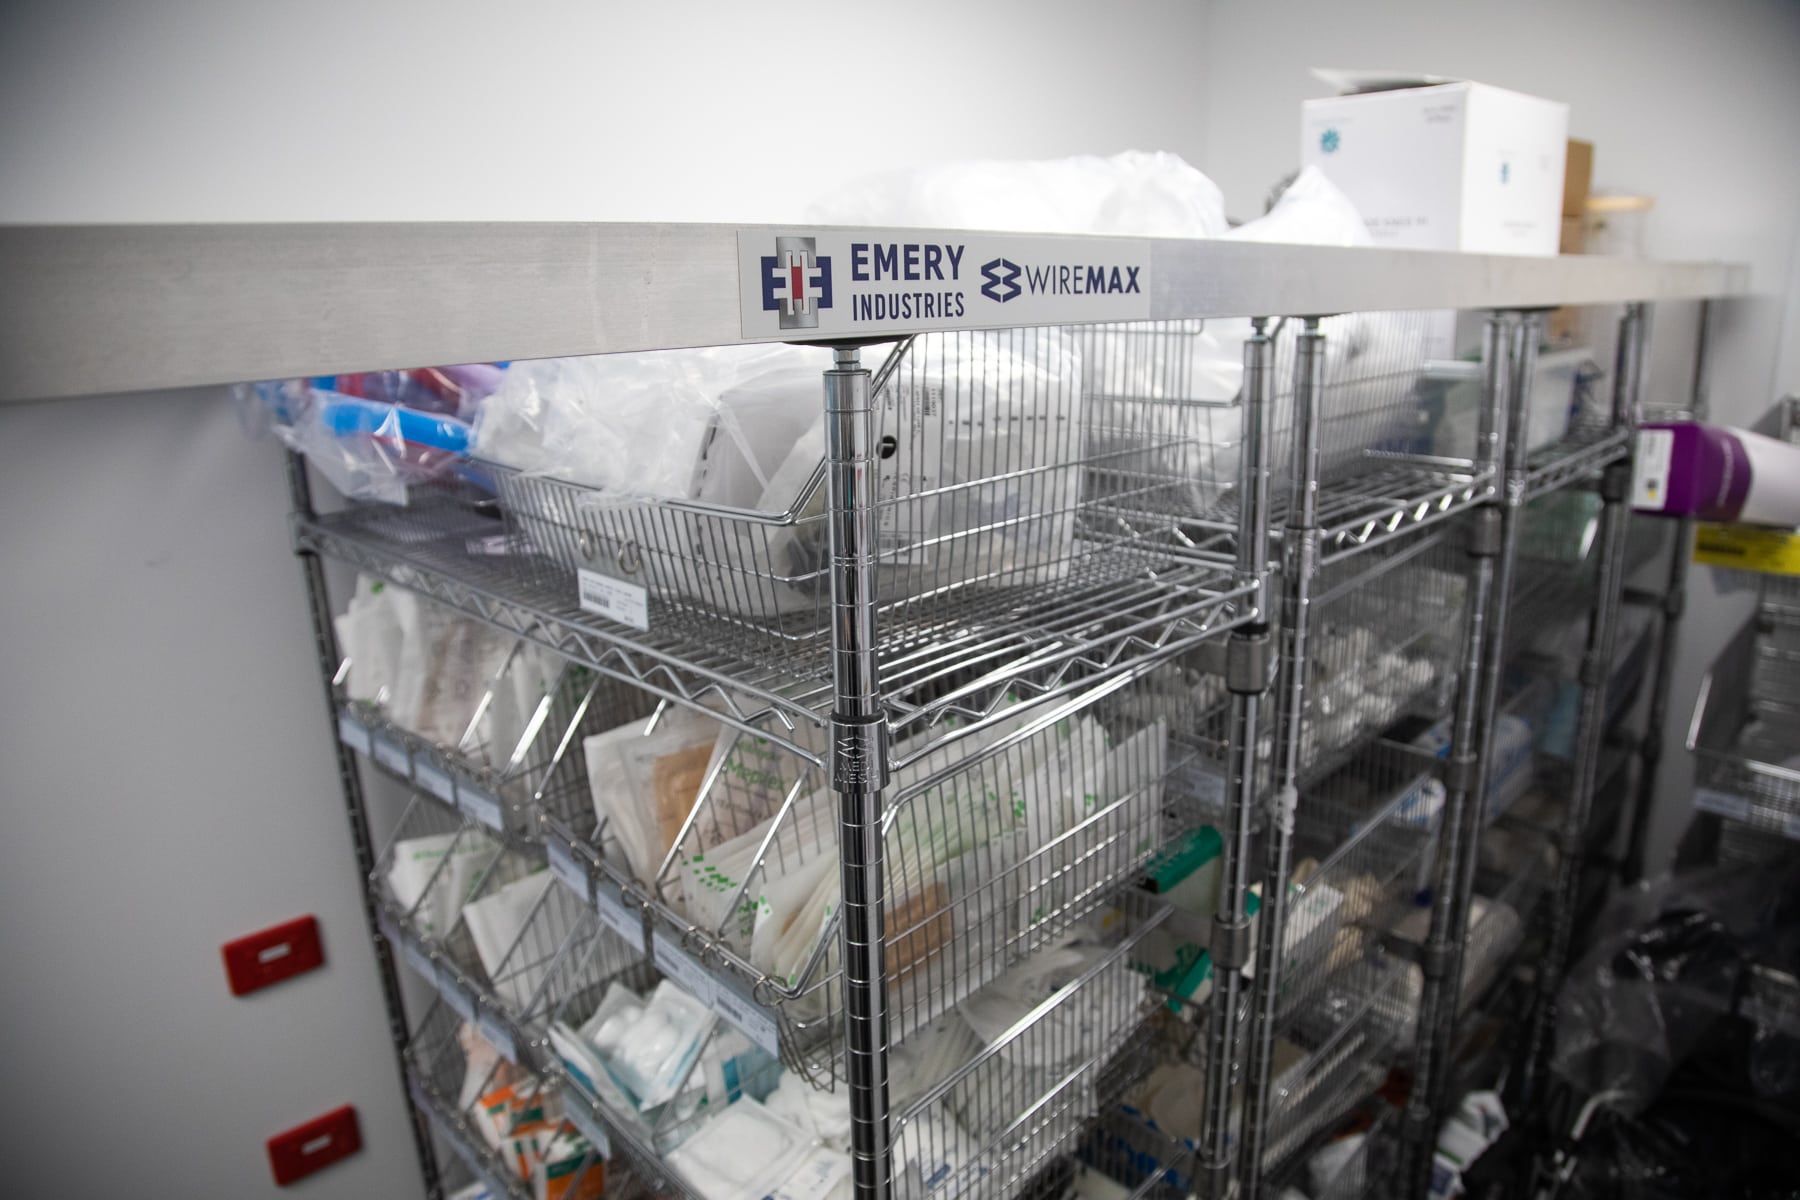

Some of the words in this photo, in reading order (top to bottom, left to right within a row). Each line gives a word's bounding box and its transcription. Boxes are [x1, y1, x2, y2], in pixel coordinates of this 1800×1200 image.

[851, 243, 965, 281] EMERY
[1025, 265, 1140, 295] WIREMAX
[852, 292, 965, 321] INDUSTRIES
